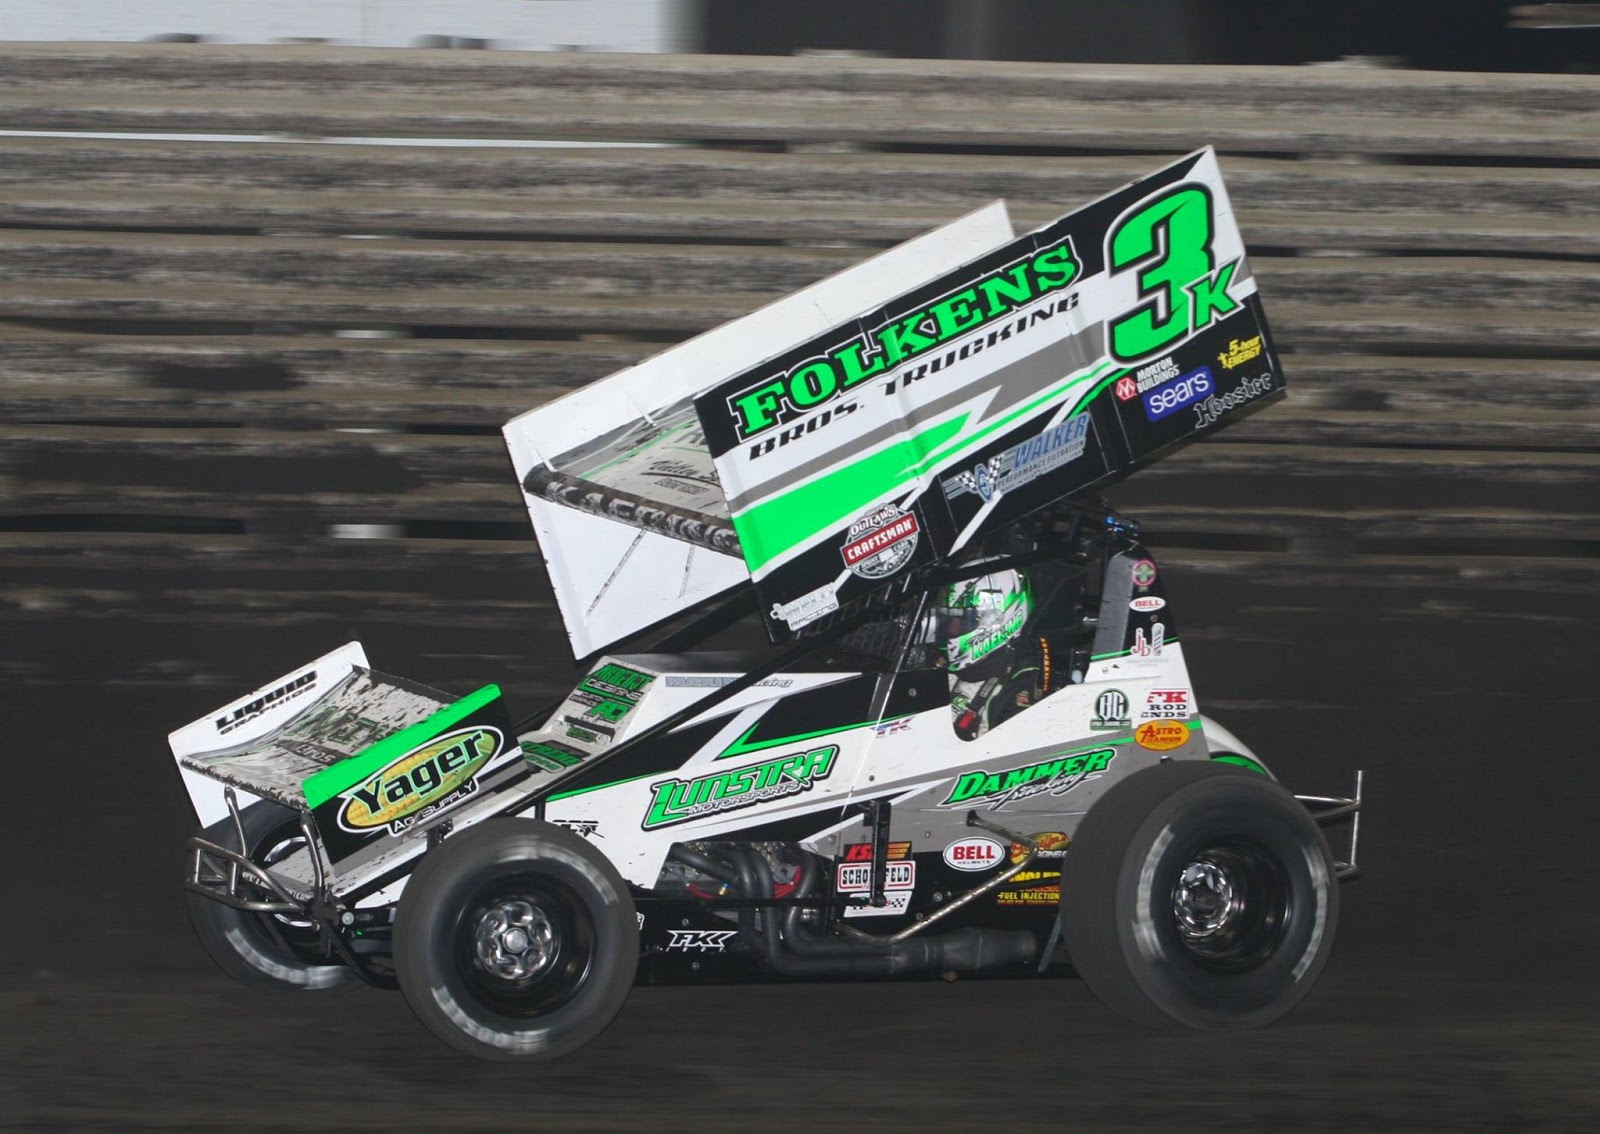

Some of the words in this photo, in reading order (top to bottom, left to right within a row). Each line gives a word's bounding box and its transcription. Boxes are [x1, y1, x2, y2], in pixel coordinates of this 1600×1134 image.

[1109, 185, 1239, 359] 3K
[733, 240, 1079, 437] FOLKENS
[1228, 344, 1261, 369] ENERGY
[750, 401, 865, 461] BROS.
[880, 292, 1080, 396] TRUCKING
[1137, 357, 1173, 382] MORTON
[1137, 365, 1180, 393] BUILDINGS
[1150, 373, 1210, 414] sears
[1193, 373, 1271, 428] Hoosier
[1013, 414, 1088, 469] WALKER
[998, 460, 1047, 488] PERFORMANCE
[847, 519, 912, 560] CRAFTSMAN
[1135, 600, 1161, 608] BELL
[215, 670, 317, 730] LIQUID
[220, 683, 316, 735] GRAPHICS
[1146, 725, 1181, 737] ASTRO
[353, 732, 484, 815] Yager
[645, 747, 837, 827] LUNSTRA
[946, 749, 1115, 804] DAMMER
[689, 781, 800, 814] MOTORSPORTS
[953, 845, 996, 860] BELL
[999, 892, 1018, 900] FUEL
[1020, 892, 1060, 900] INJECTION
